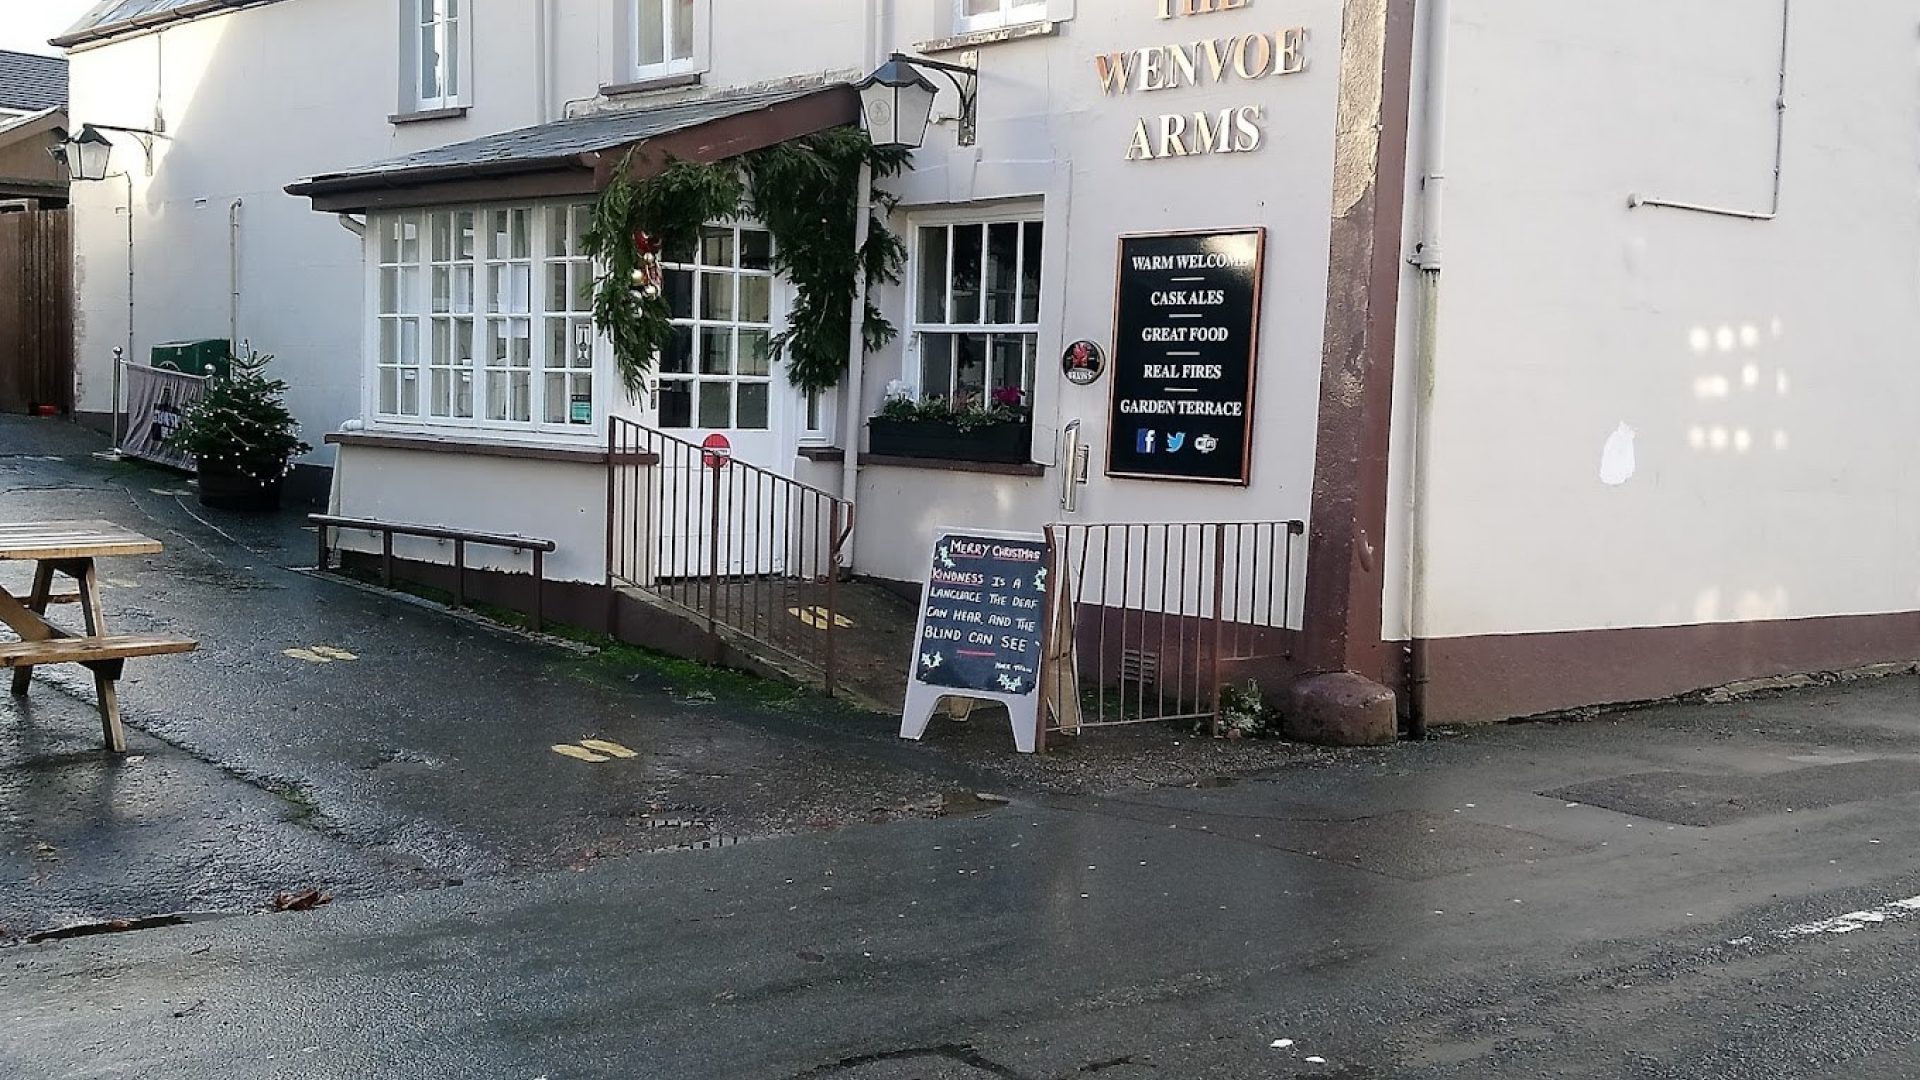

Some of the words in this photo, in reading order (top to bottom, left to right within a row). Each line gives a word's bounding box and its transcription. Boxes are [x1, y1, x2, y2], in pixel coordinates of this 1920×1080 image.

[1095, 26, 1306, 95] WENVOE
[1124, 104, 1262, 160] ARMS
[1132, 254, 1174, 270] WARM
[1151, 291, 1186, 306] CASK
[1188, 289, 1224, 305] ALES
[1141, 327, 1187, 342] GREAT
[1189, 326, 1229, 342] FOOD
[1143, 364, 1180, 379] REAL
[1181, 364, 1222, 380] FIRES
[1120, 399, 1176, 414] GARDEN
[1177, 400, 1242, 417] TERRACE
[949, 539, 991, 557] MERRY
[932, 566, 984, 585] KINDNESS
[1012, 578, 1022, 589] A
[930, 586, 983, 603] LANGUAGE
[989, 593, 1008, 606] THE
[1011, 595, 1040, 610] DEAF
[926, 605, 949, 619] CAN
[988, 614, 1012, 627] AND
[1015, 617, 1037, 633] THE
[924, 625, 962, 641] BLIND
[968, 631, 994, 646] CAN
[1000, 635, 1029, 652] SEE
